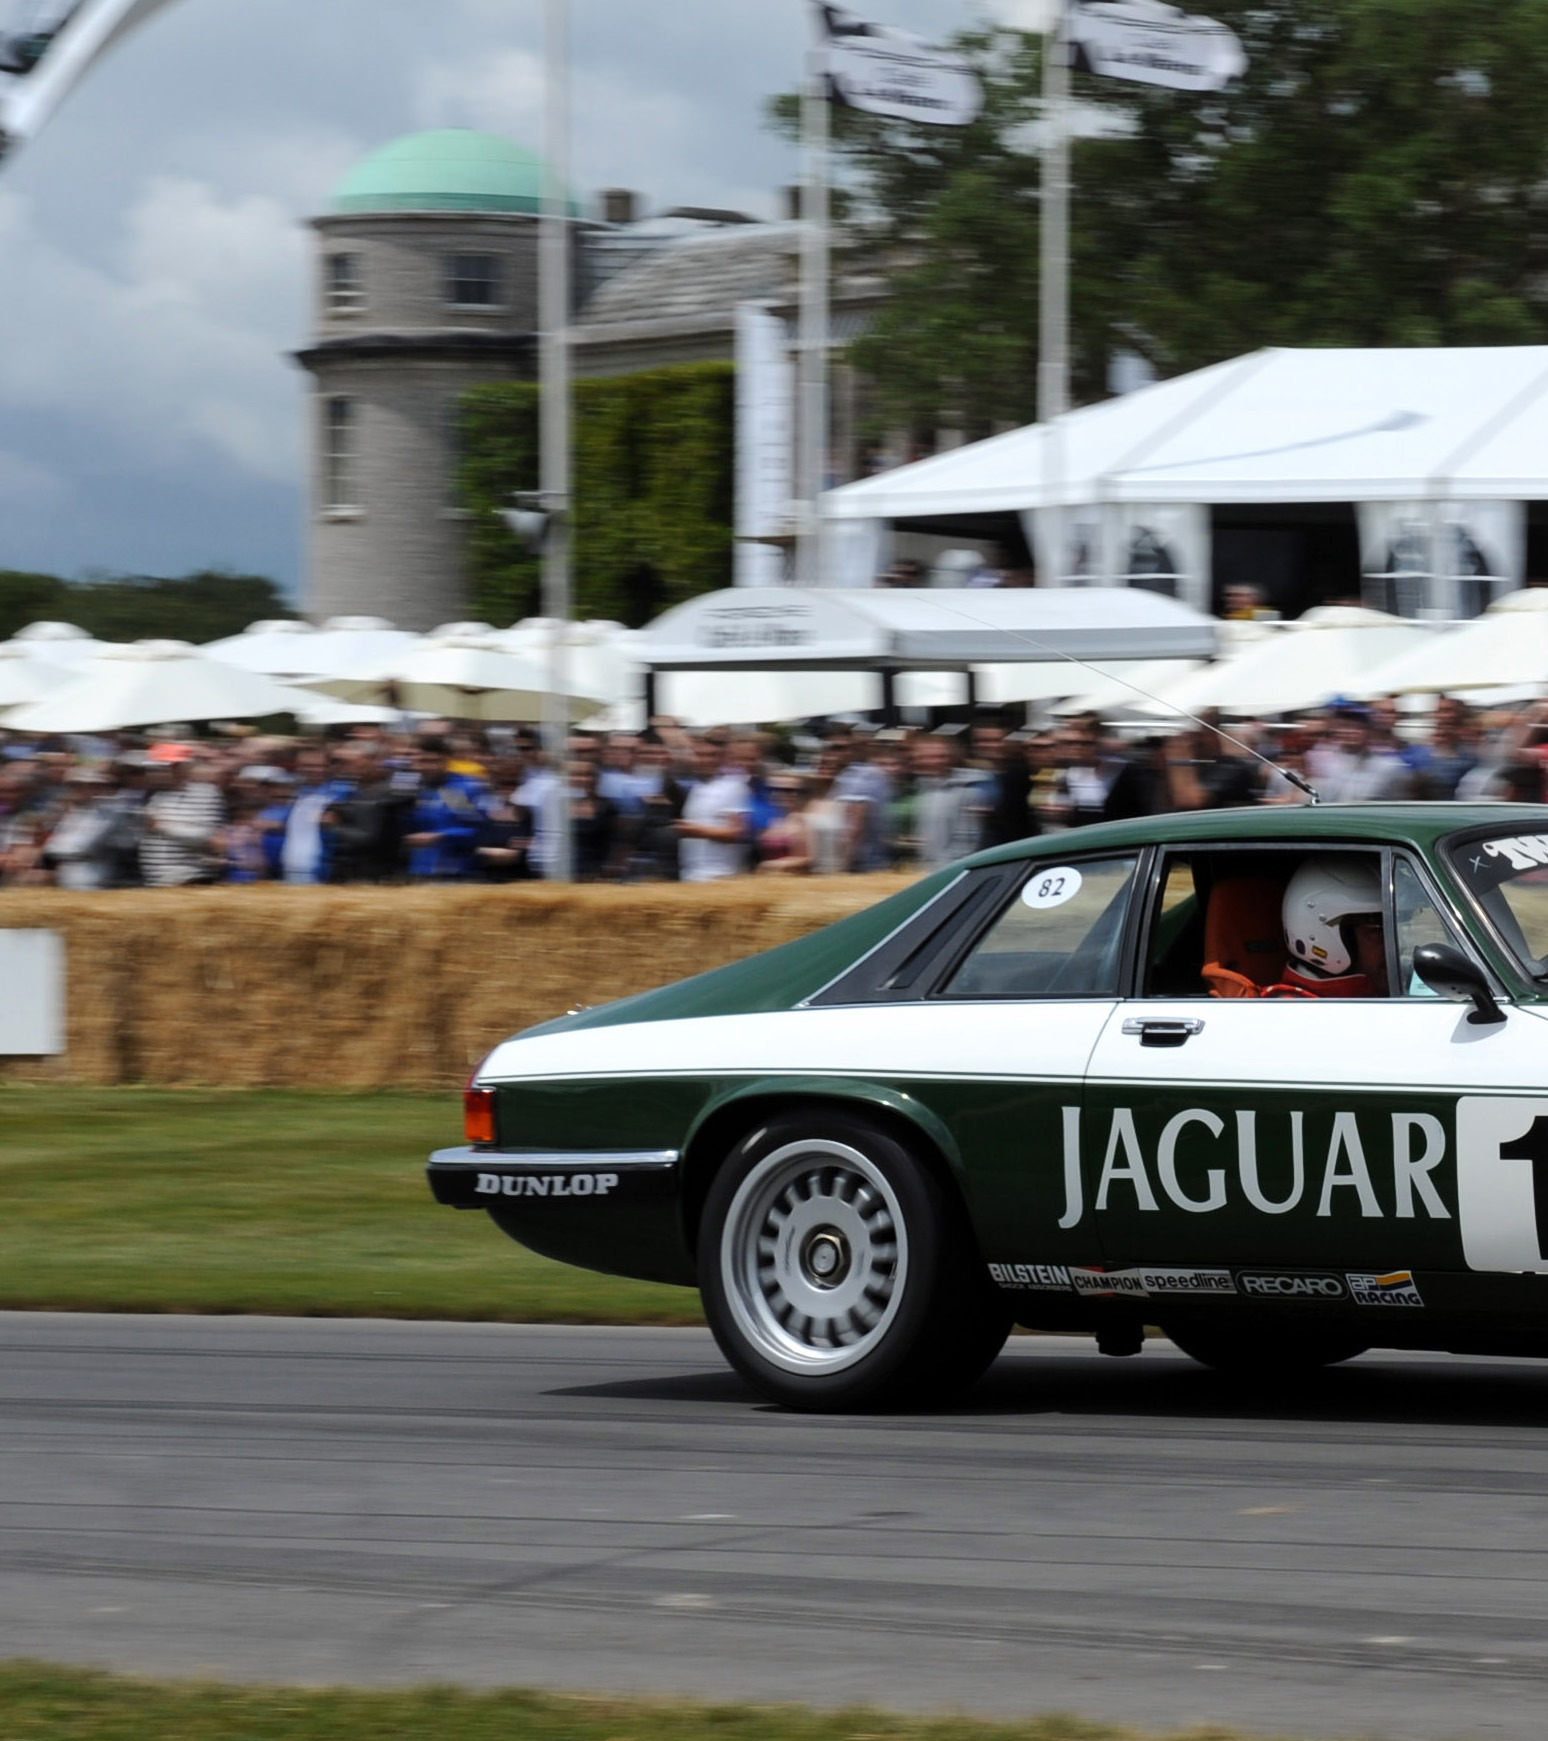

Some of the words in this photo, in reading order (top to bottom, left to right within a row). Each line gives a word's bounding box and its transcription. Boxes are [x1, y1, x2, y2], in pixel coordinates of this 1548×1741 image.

[1038, 877, 1066, 898] 82
[1057, 1105, 1453, 1229] JAGUAR
[474, 1173, 620, 1196] DUNLOP
[987, 1263, 1073, 1285] BILSTEIN
[1073, 1275, 1144, 1291] CHAMPION
[1144, 1272, 1231, 1290] speedline
[1242, 1276, 1343, 1296] RECARO
[1354, 1291, 1423, 1306] RACING
